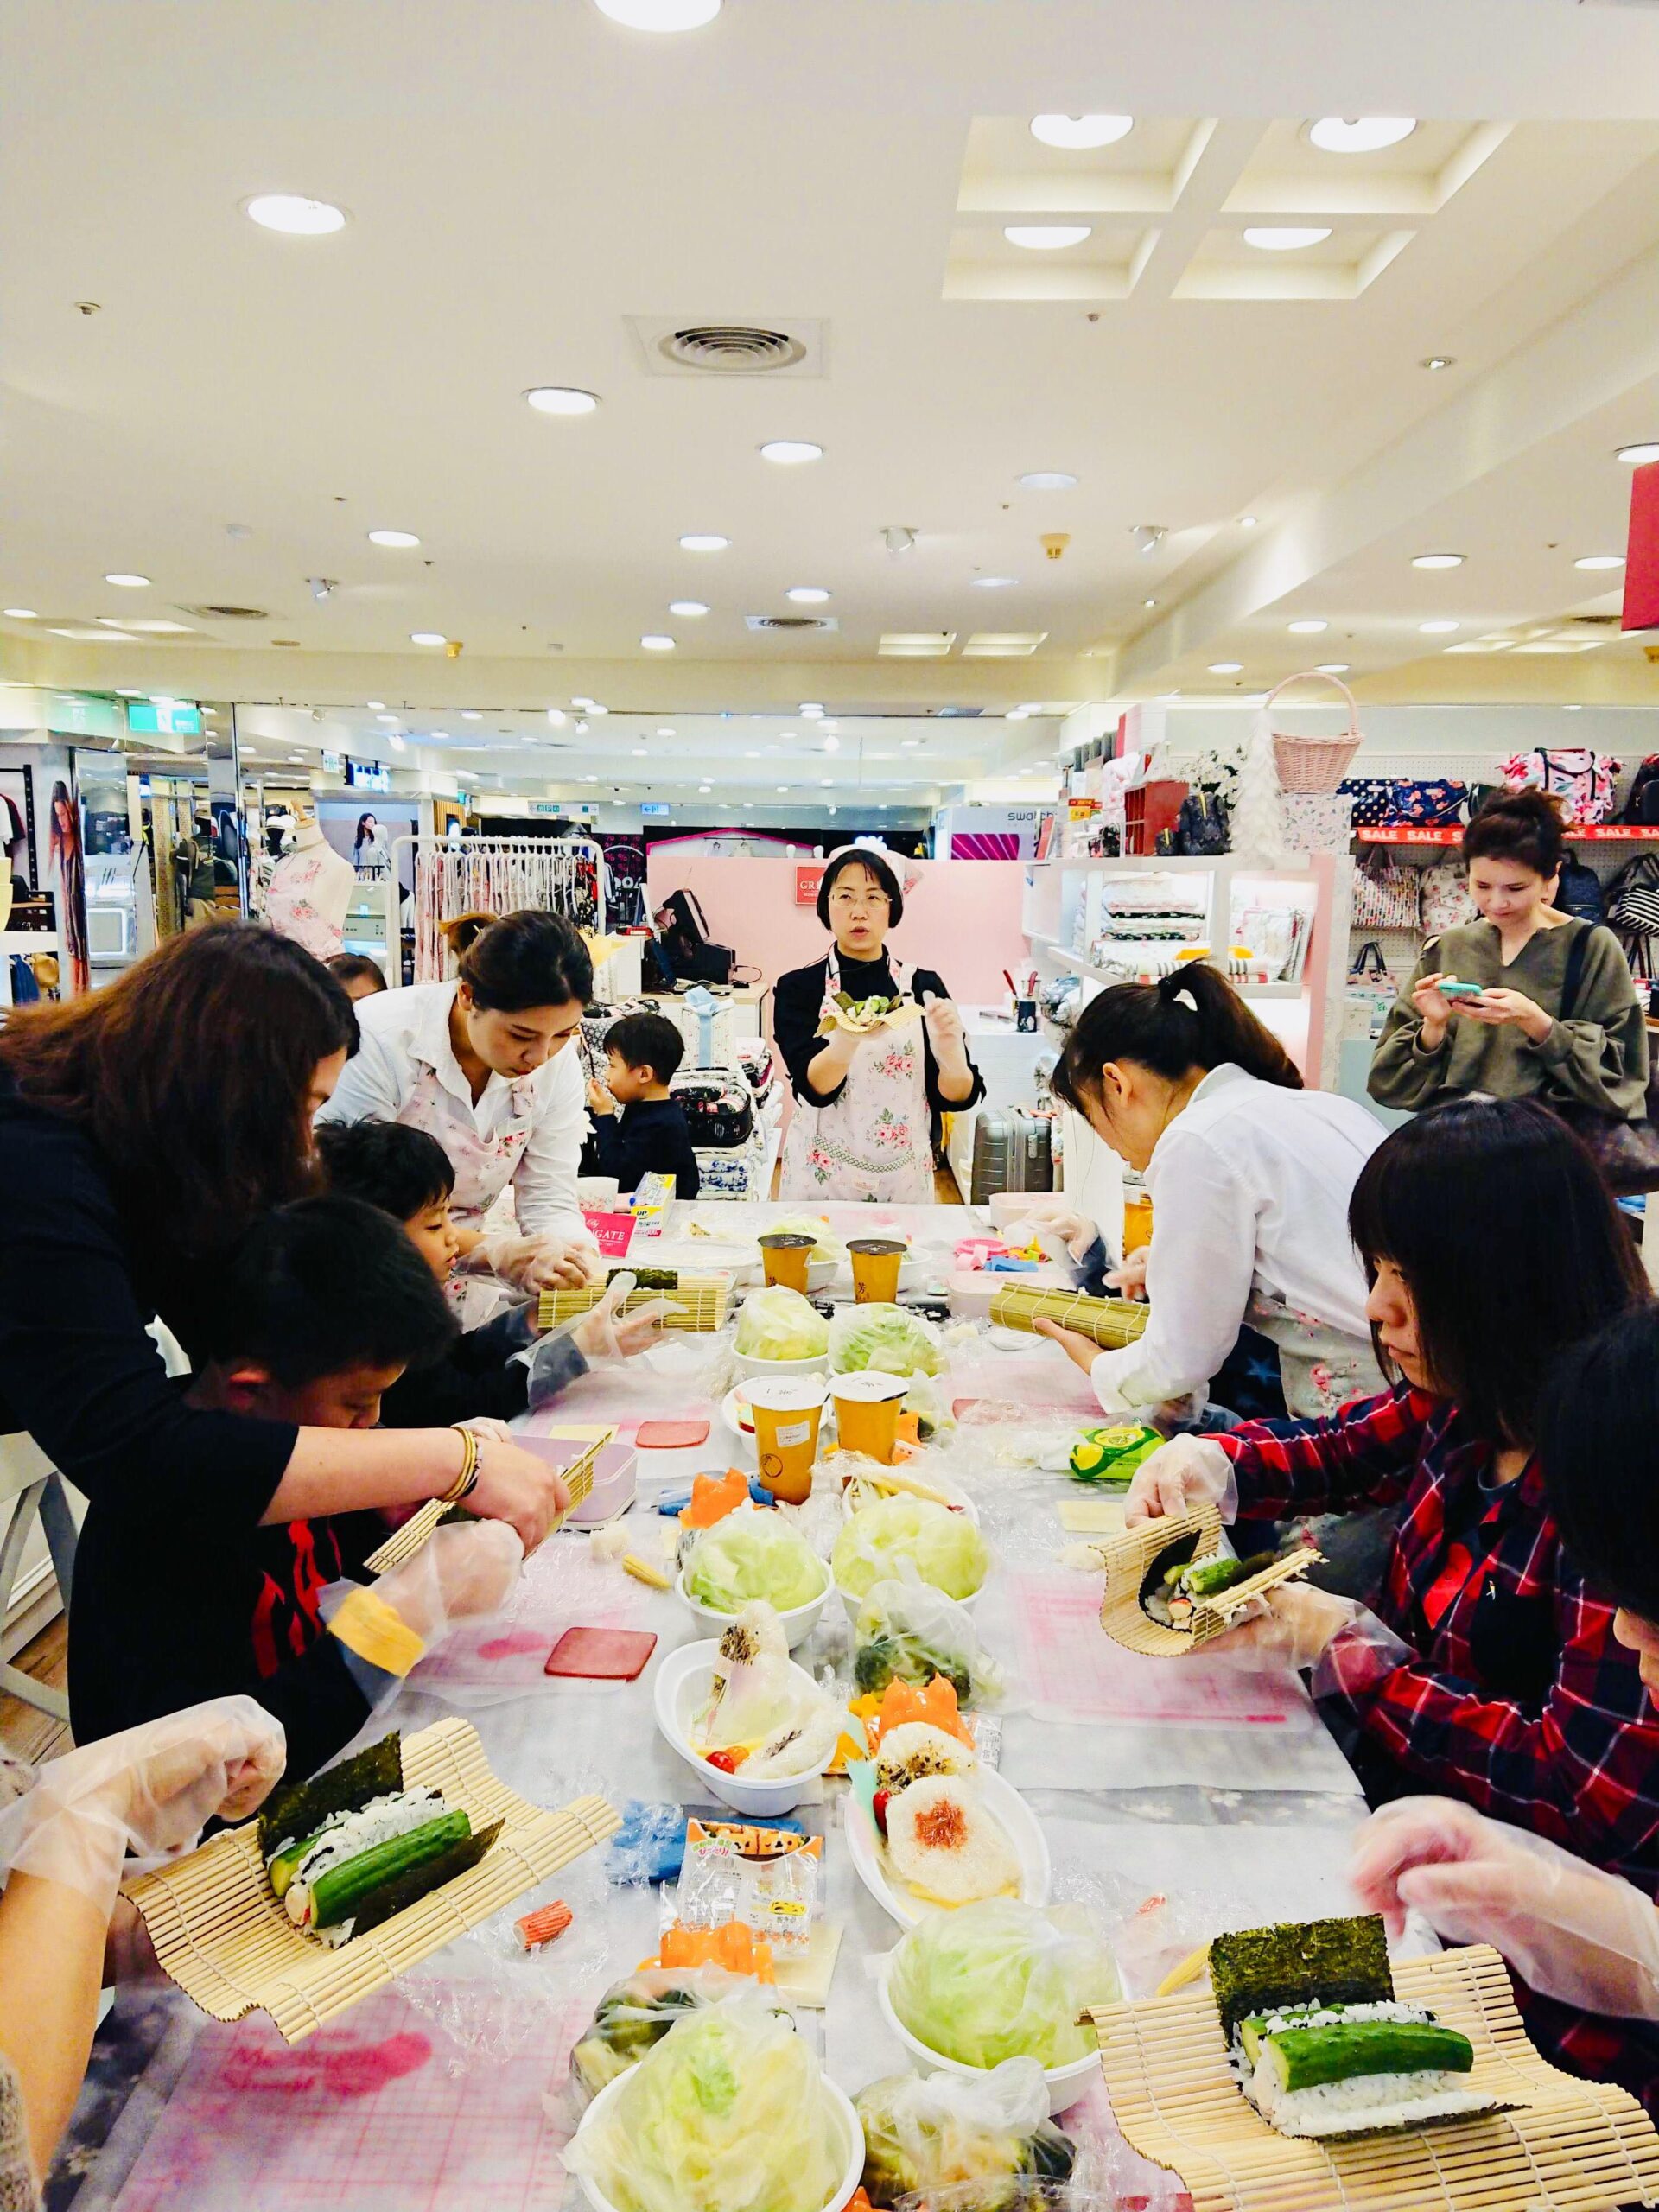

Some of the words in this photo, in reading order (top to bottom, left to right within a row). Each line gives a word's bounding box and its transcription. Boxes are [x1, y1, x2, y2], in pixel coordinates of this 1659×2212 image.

[1362, 830, 1399, 840] SALE
[1407, 830, 1443, 842] SALE
[1595, 828, 1631, 837] SALE
